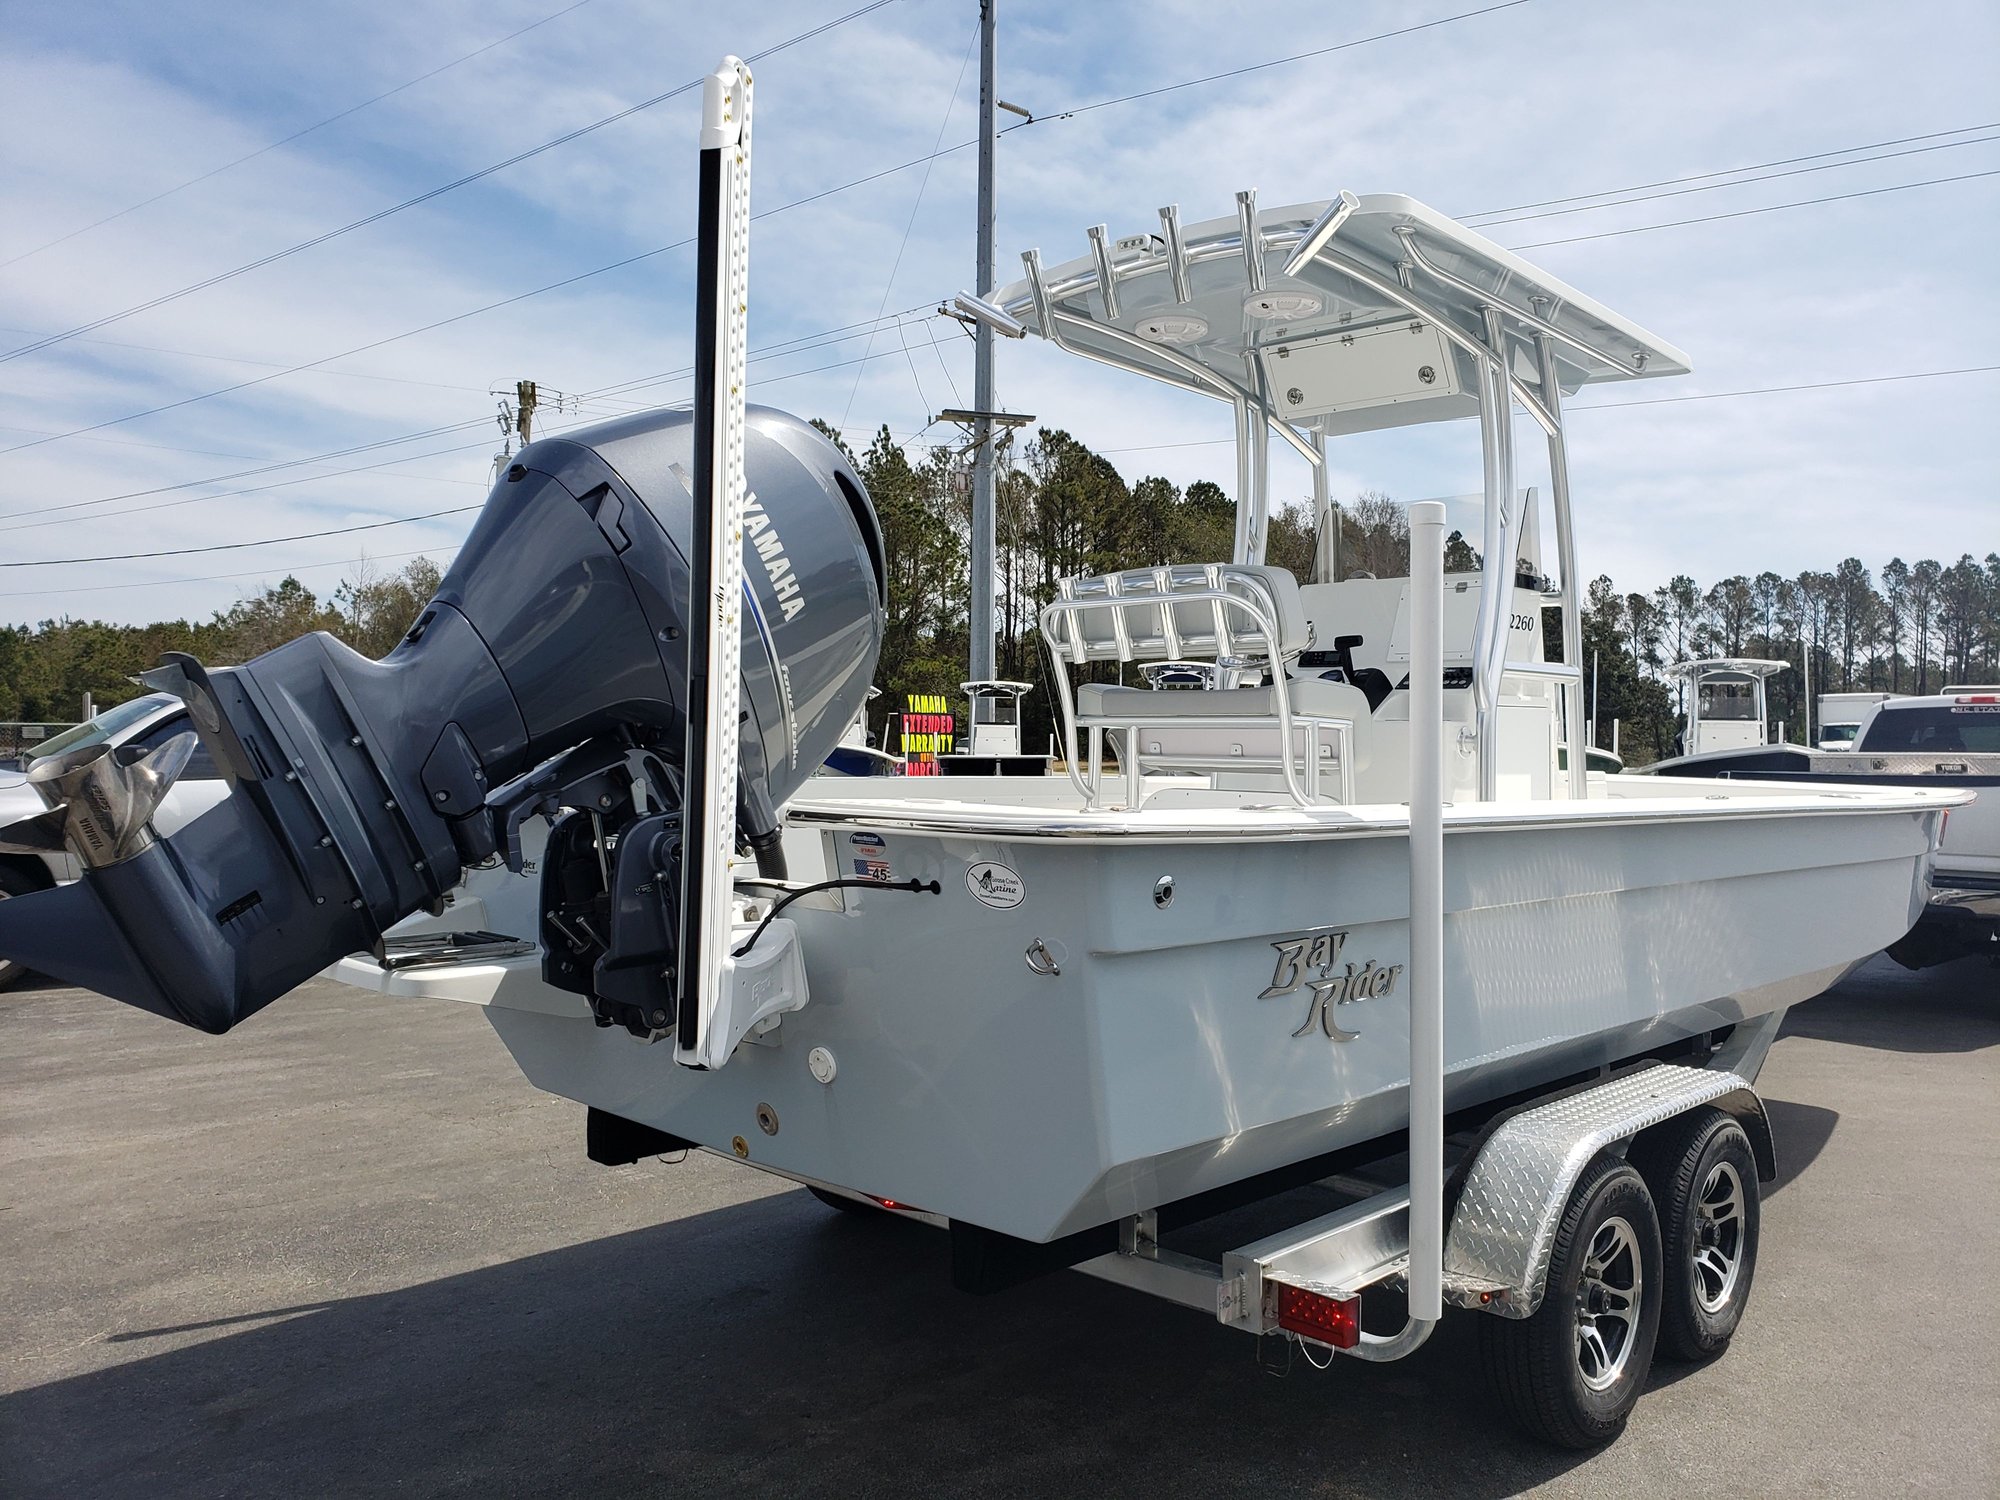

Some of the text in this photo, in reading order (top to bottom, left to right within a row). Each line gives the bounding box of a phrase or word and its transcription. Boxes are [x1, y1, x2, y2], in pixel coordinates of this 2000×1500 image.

[743, 491, 806, 623] YAMAHA
[1510, 613, 1535, 632] 2260
[907, 694, 947, 713] YAMAHA
[902, 714, 953, 733] EXTENDED
[79, 817, 104, 851] YAMAHA
[872, 867, 887, 881] 45
[1257, 931, 1350, 1000] Bay
[1291, 959, 1404, 1043] Rider
